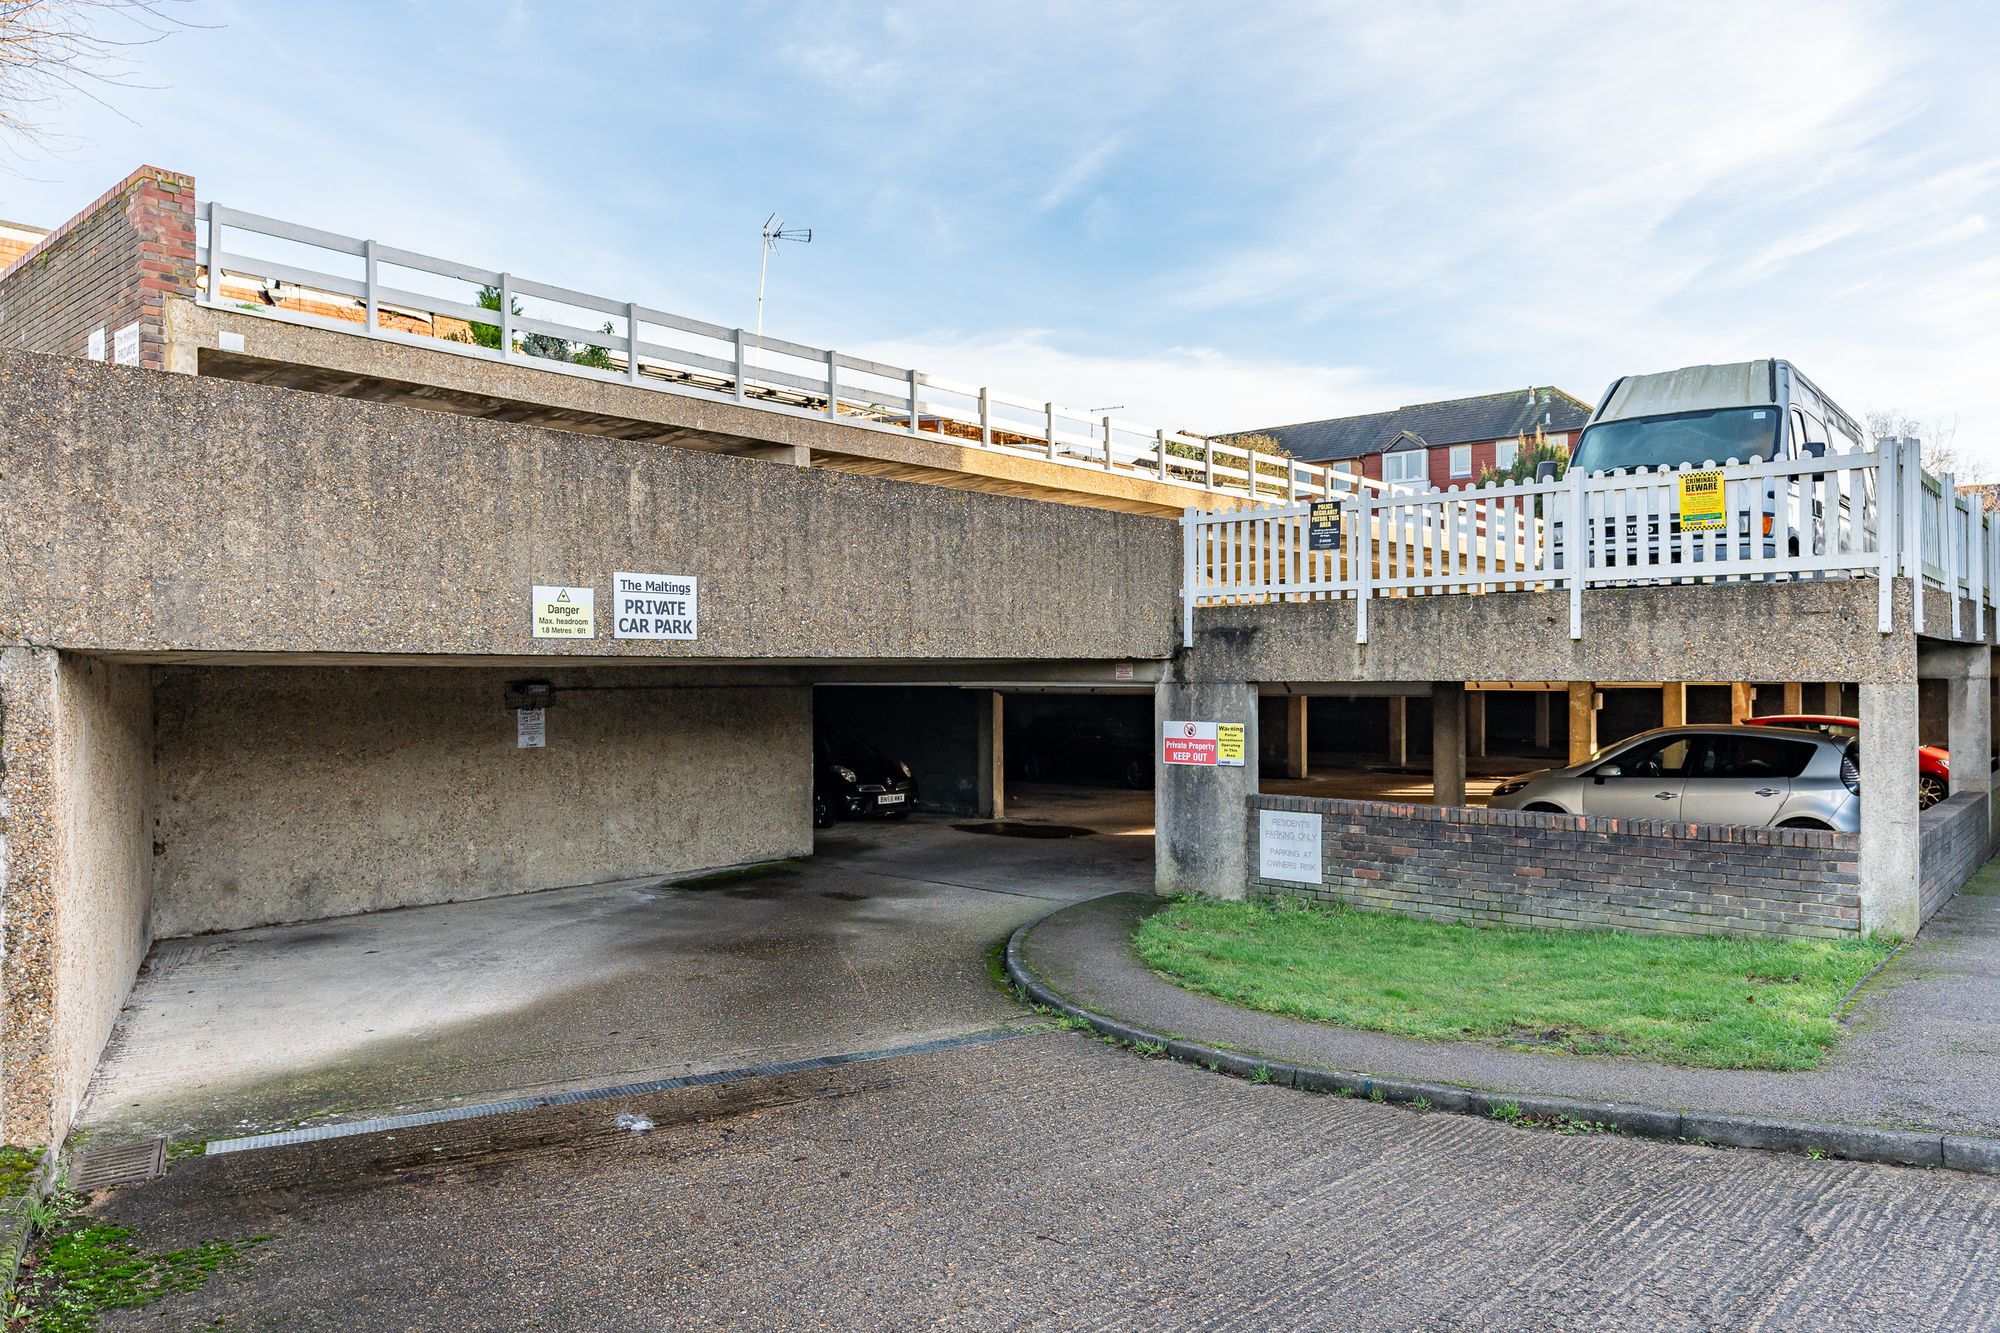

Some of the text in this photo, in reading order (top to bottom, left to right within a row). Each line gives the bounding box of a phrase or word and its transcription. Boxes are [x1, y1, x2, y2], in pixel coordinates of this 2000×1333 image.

[1685, 476, 1718, 484] CRIMINALS
[1686, 482, 1718, 492] BEWARE
[620, 580, 691, 595] The Maltings
[547, 604, 580, 616] Danger
[625, 599, 686, 616] PRIVATE
[539, 617, 589, 626] Max. headroom
[618, 618, 693, 634] CAR PARK
[1166, 741, 1215, 752] Private Property
[1173, 752, 1208, 761] KEEP OUT
[1272, 818, 1310, 829] RESIDENTS
[1265, 830, 1317, 841] PARKING ONLY
[1270, 848, 1312, 859] PARKING AT
[1267, 860, 1316, 872] OWNERS RISK
